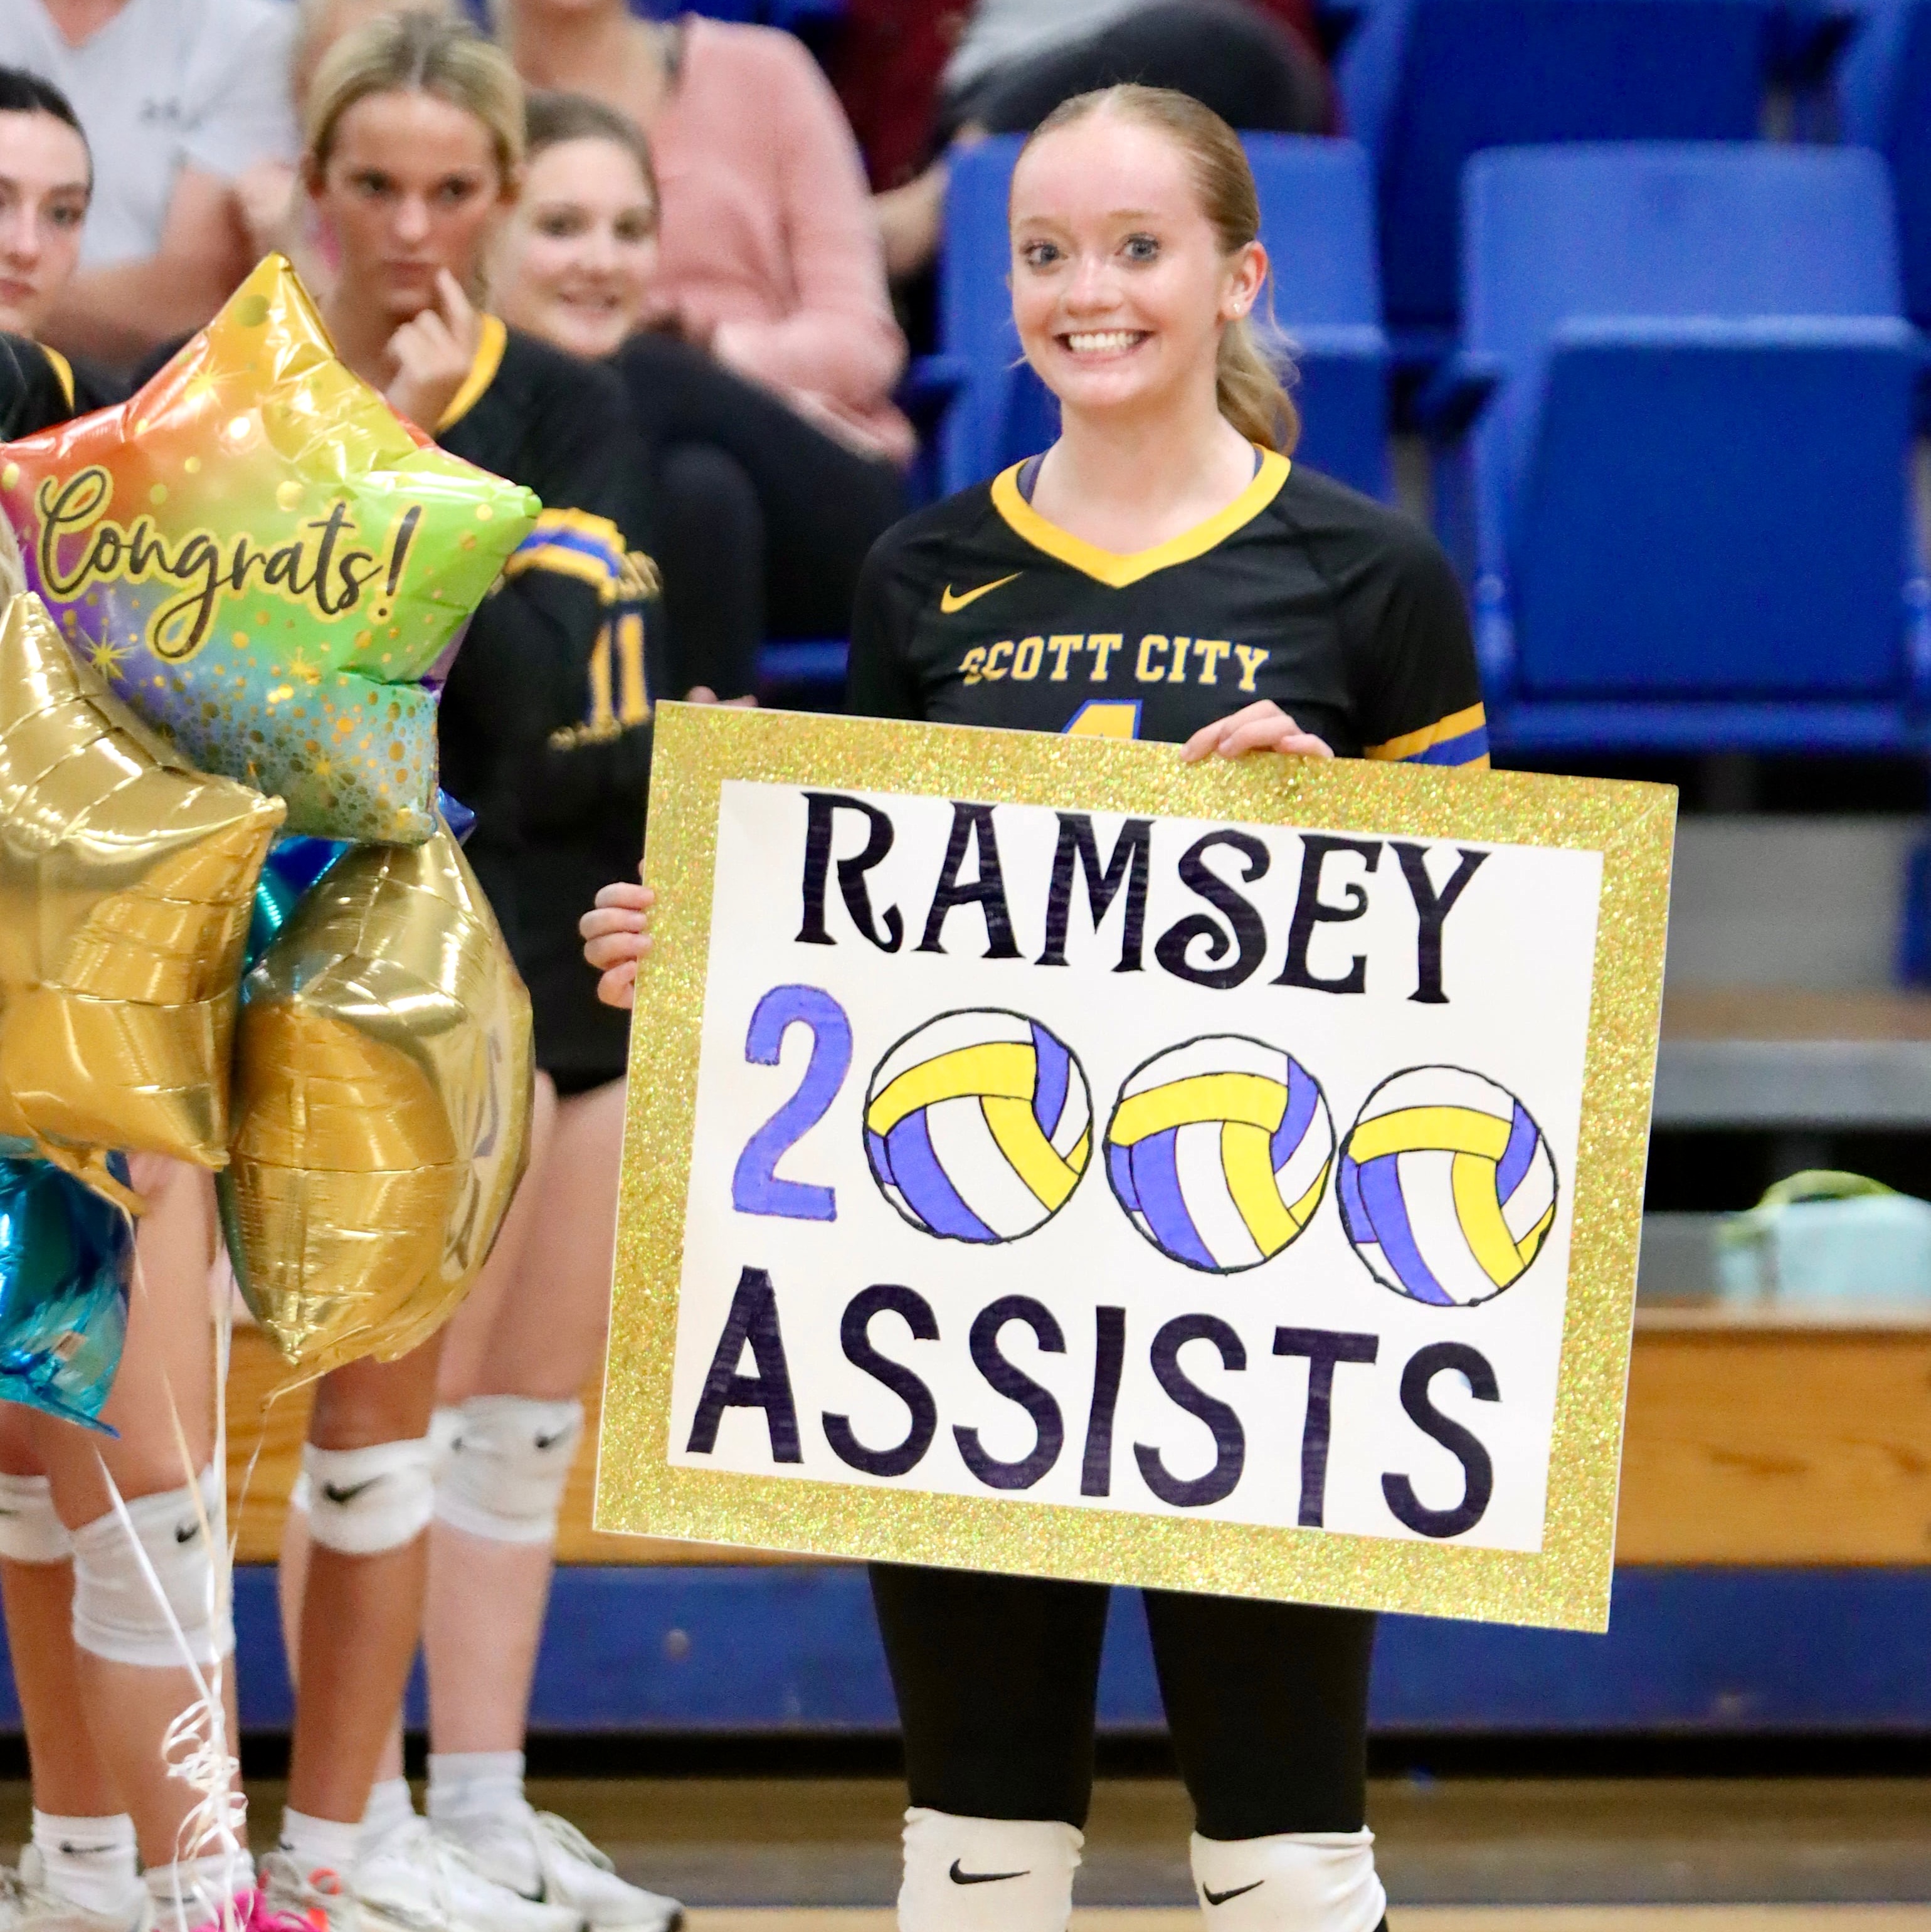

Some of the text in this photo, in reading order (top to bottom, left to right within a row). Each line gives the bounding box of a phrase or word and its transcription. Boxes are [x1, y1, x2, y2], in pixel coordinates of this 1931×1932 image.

[38, 467, 423, 660] Congrats!
[958, 633, 1271, 692] SCOTT CITY
[793, 791, 1490, 1005] RAMSEY
[685, 1265, 1501, 1539] ASSISTS
